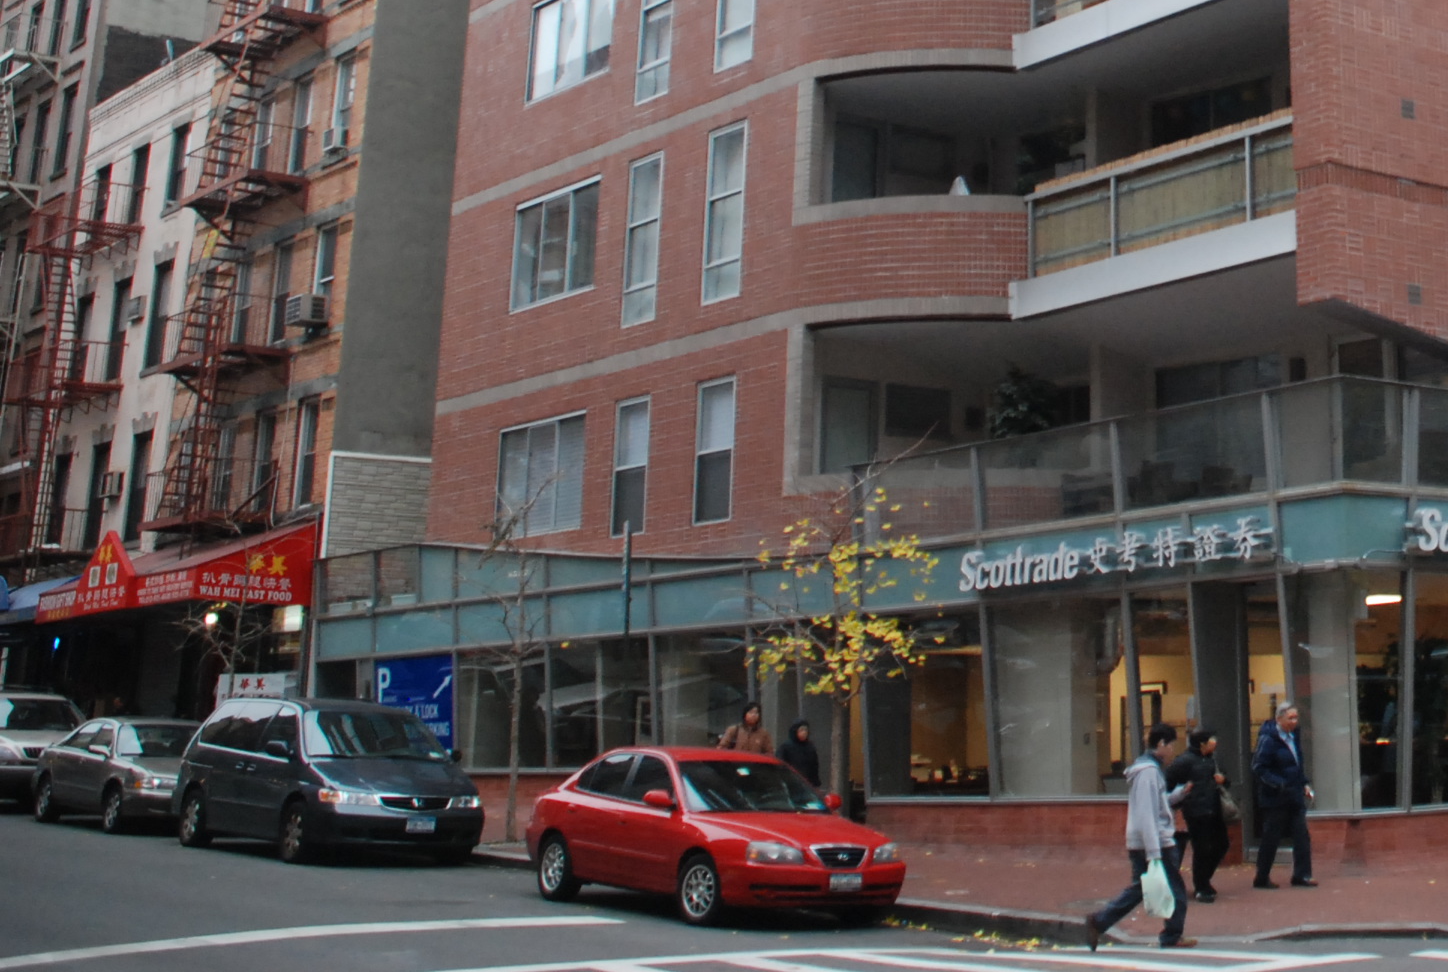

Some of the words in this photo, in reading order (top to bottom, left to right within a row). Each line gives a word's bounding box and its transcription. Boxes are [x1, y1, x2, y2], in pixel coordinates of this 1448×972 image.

[959, 542, 1080, 592] Scottrade
[199, 585, 220, 597] WAH
[223, 587, 239, 598] MEI
[267, 590, 292, 601] FOOD
[377, 668, 391, 703] P
